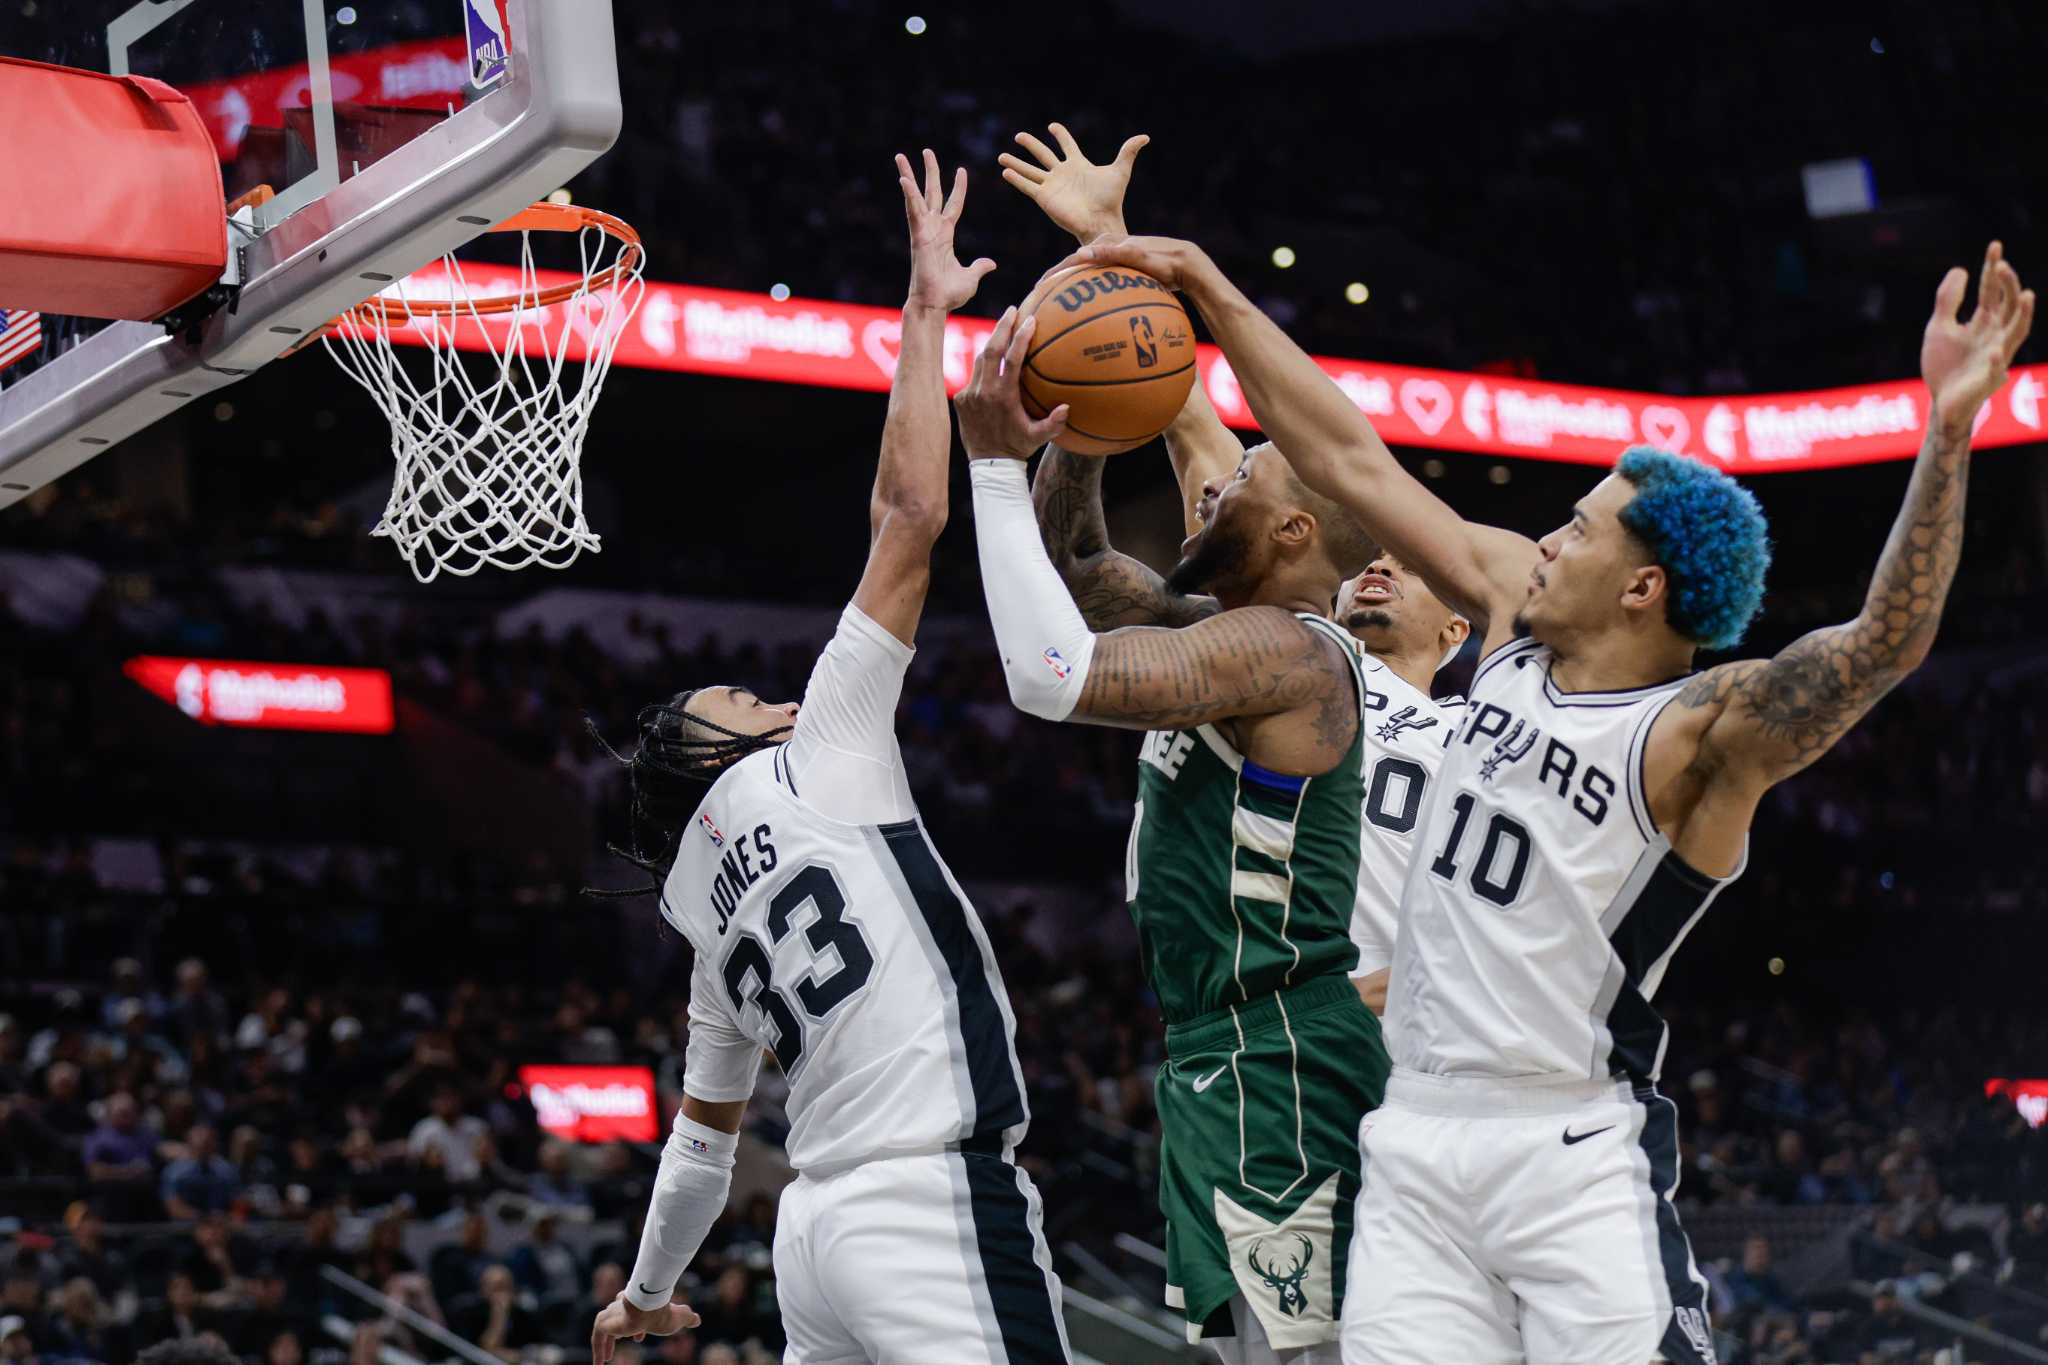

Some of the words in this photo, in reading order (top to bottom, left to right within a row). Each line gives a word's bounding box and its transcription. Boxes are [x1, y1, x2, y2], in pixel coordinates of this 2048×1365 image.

[710, 823, 778, 936] JONES
[1429, 791, 1533, 908] 10
[720, 862, 878, 1084] 33
